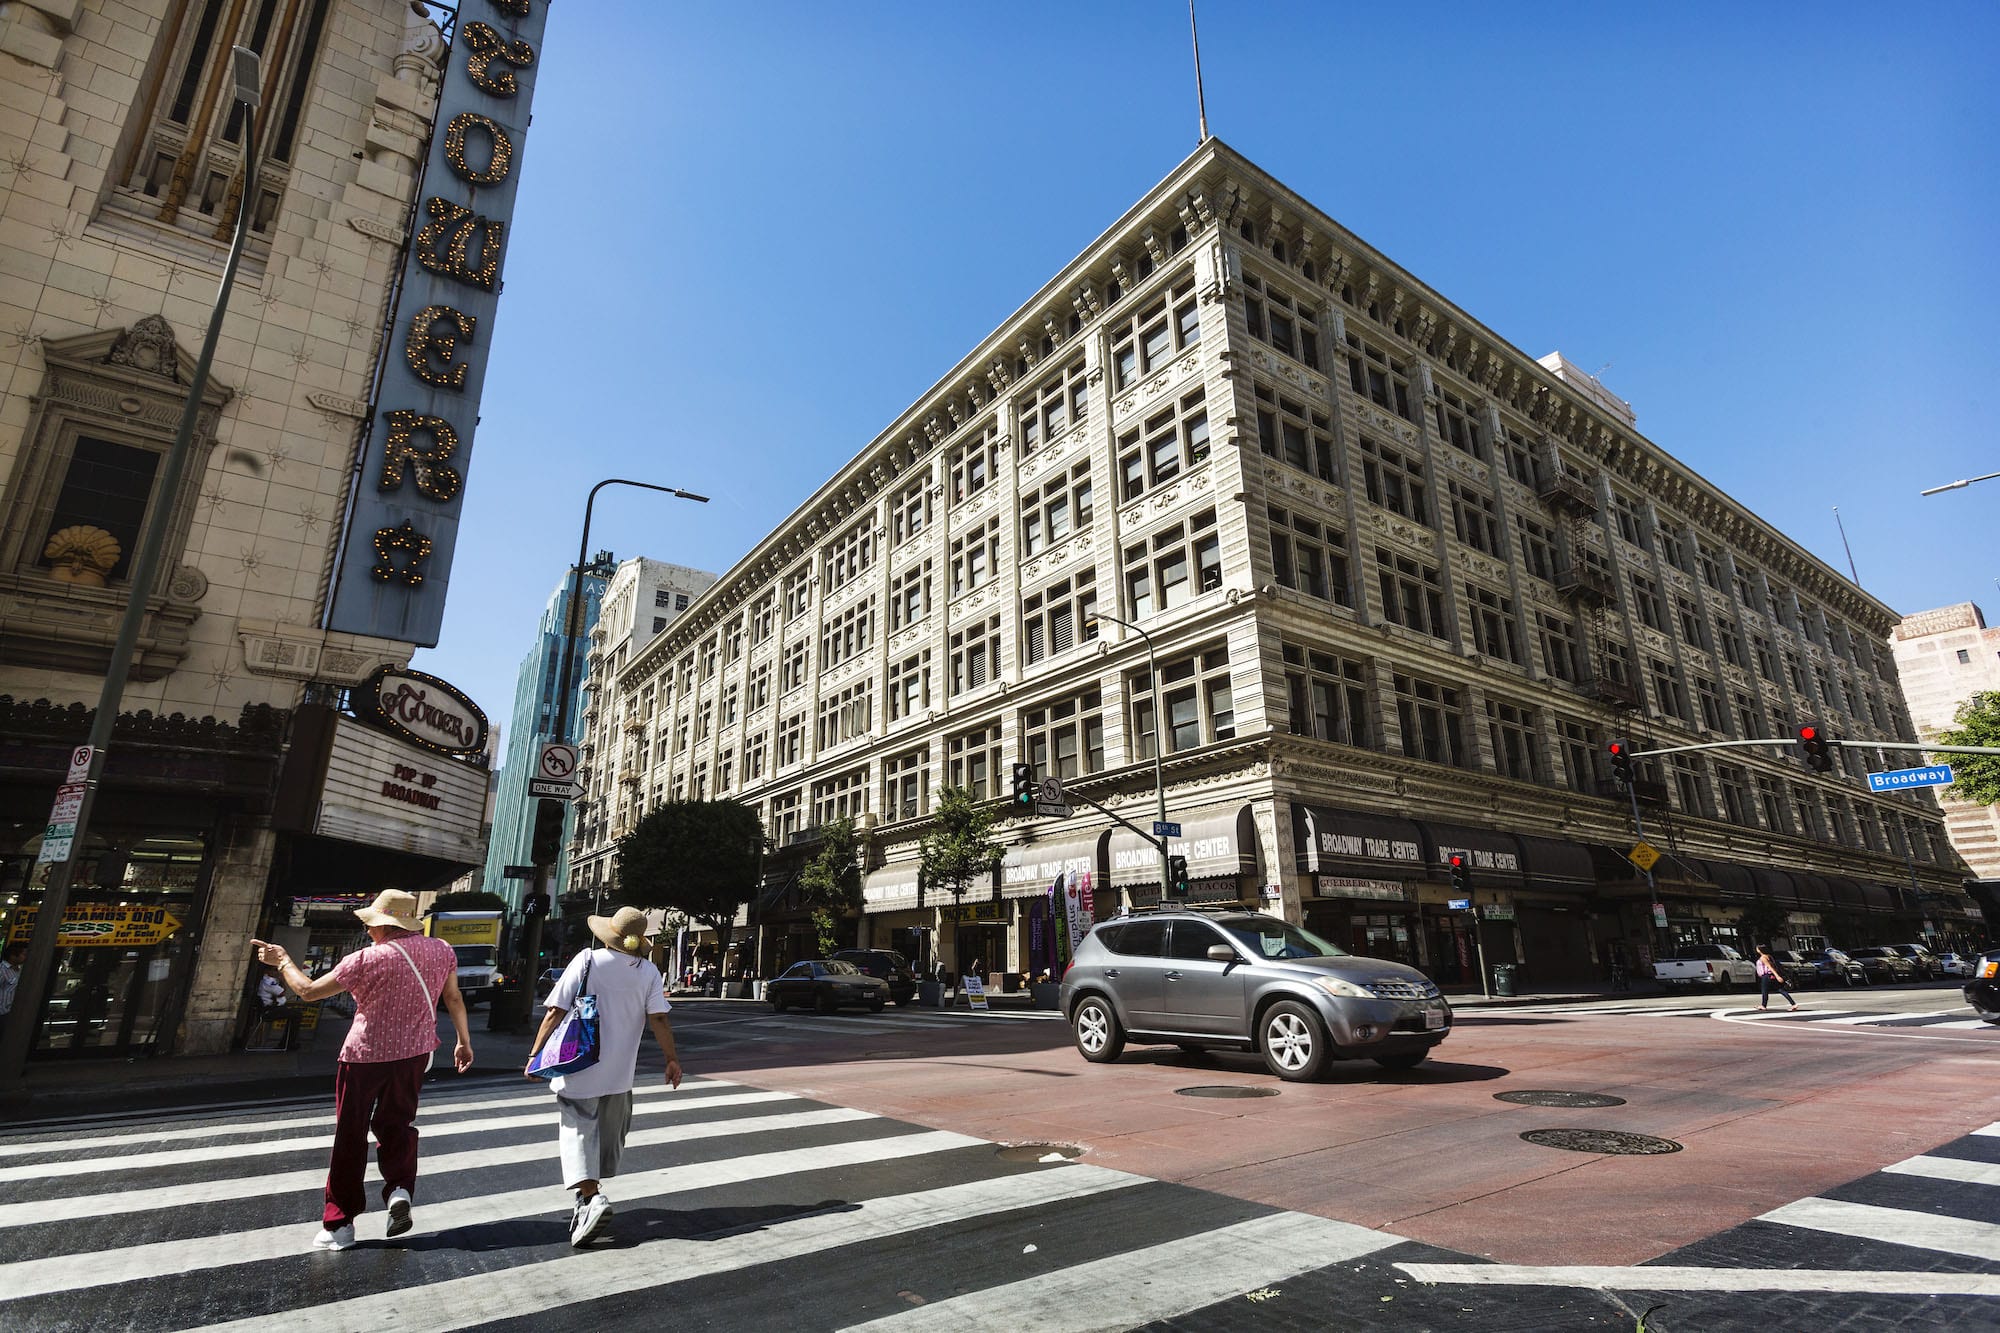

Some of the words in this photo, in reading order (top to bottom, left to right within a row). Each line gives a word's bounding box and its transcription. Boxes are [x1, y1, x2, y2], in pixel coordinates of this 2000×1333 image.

[394, 763, 416, 782] POP
[422, 772, 437, 788] UP
[1874, 770, 1945, 786] Broadway
[382, 781, 440, 810] BROADWAY
[535, 784, 552, 793] ONE
[555, 786, 571, 794] WAY
[1039, 805, 1051, 813] ONE
[1155, 824, 1169, 834] 8th
[1171, 827, 1180, 835] St
[1115, 847, 1158, 869] BROADWAY
[1167, 842, 1190, 860] RADE
[1194, 836, 1230, 859] CENTER
[1321, 832, 1363, 855] BROADWAY
[1365, 838, 1390, 858] TRADE
[1391, 840, 1420, 861] CENTER
[1474, 850, 1494, 868] TRADE
[1495, 852, 1518, 870] CENTER
[1006, 864, 1038, 883] BROADWAY
[1040, 860, 1062, 879] TRADE
[1064, 856, 1091, 875] CENTER
[899, 882, 918, 896] CENTER
[1198, 880, 1235, 891] TACOS
[1320, 878, 1371, 888] GUERRERO
[1374, 881, 1402, 893] TACOS
[132, 909, 165, 924] ORO
[975, 904, 997, 918] SHOE
